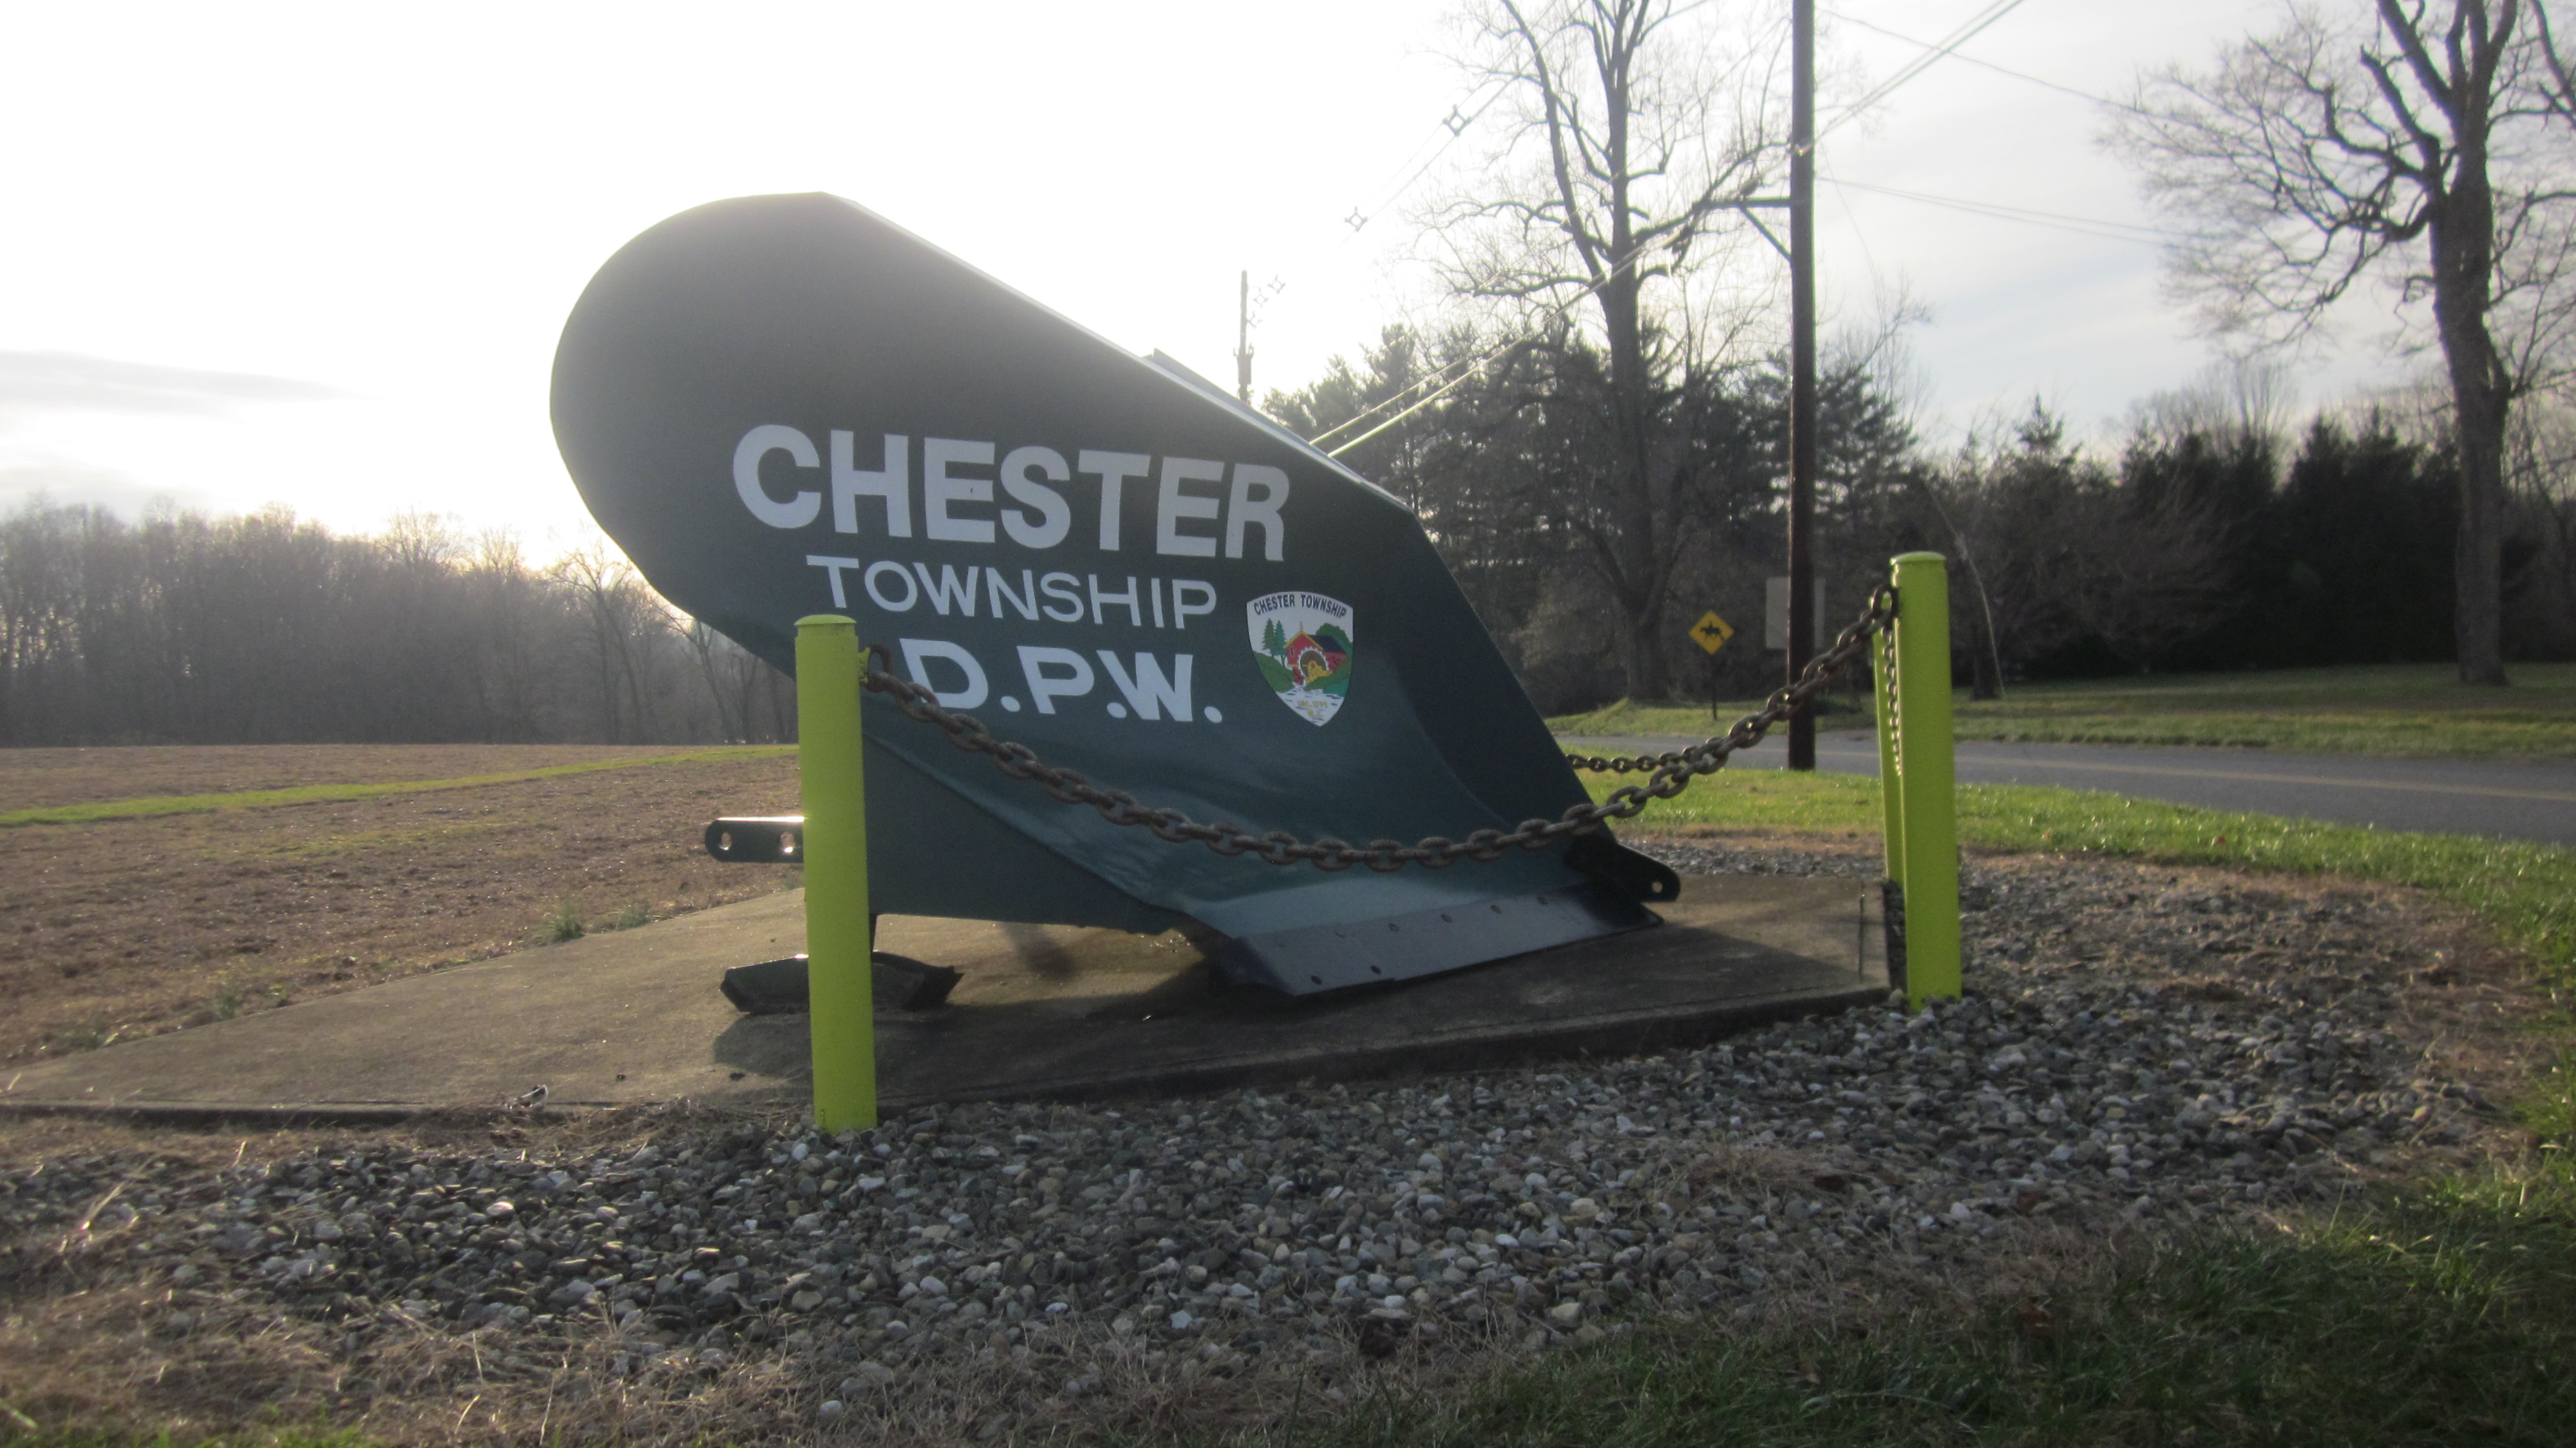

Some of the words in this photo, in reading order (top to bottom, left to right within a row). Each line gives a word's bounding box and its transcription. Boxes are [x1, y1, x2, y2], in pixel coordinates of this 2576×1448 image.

[733, 424, 1289, 562] CHESTER
[806, 555, 1217, 629] TOWNSHIP
[1253, 594, 1296, 616] CHESTER
[1300, 594, 1347, 619] TOWNSHIP
[899, 638, 1223, 723] D.P.W.
